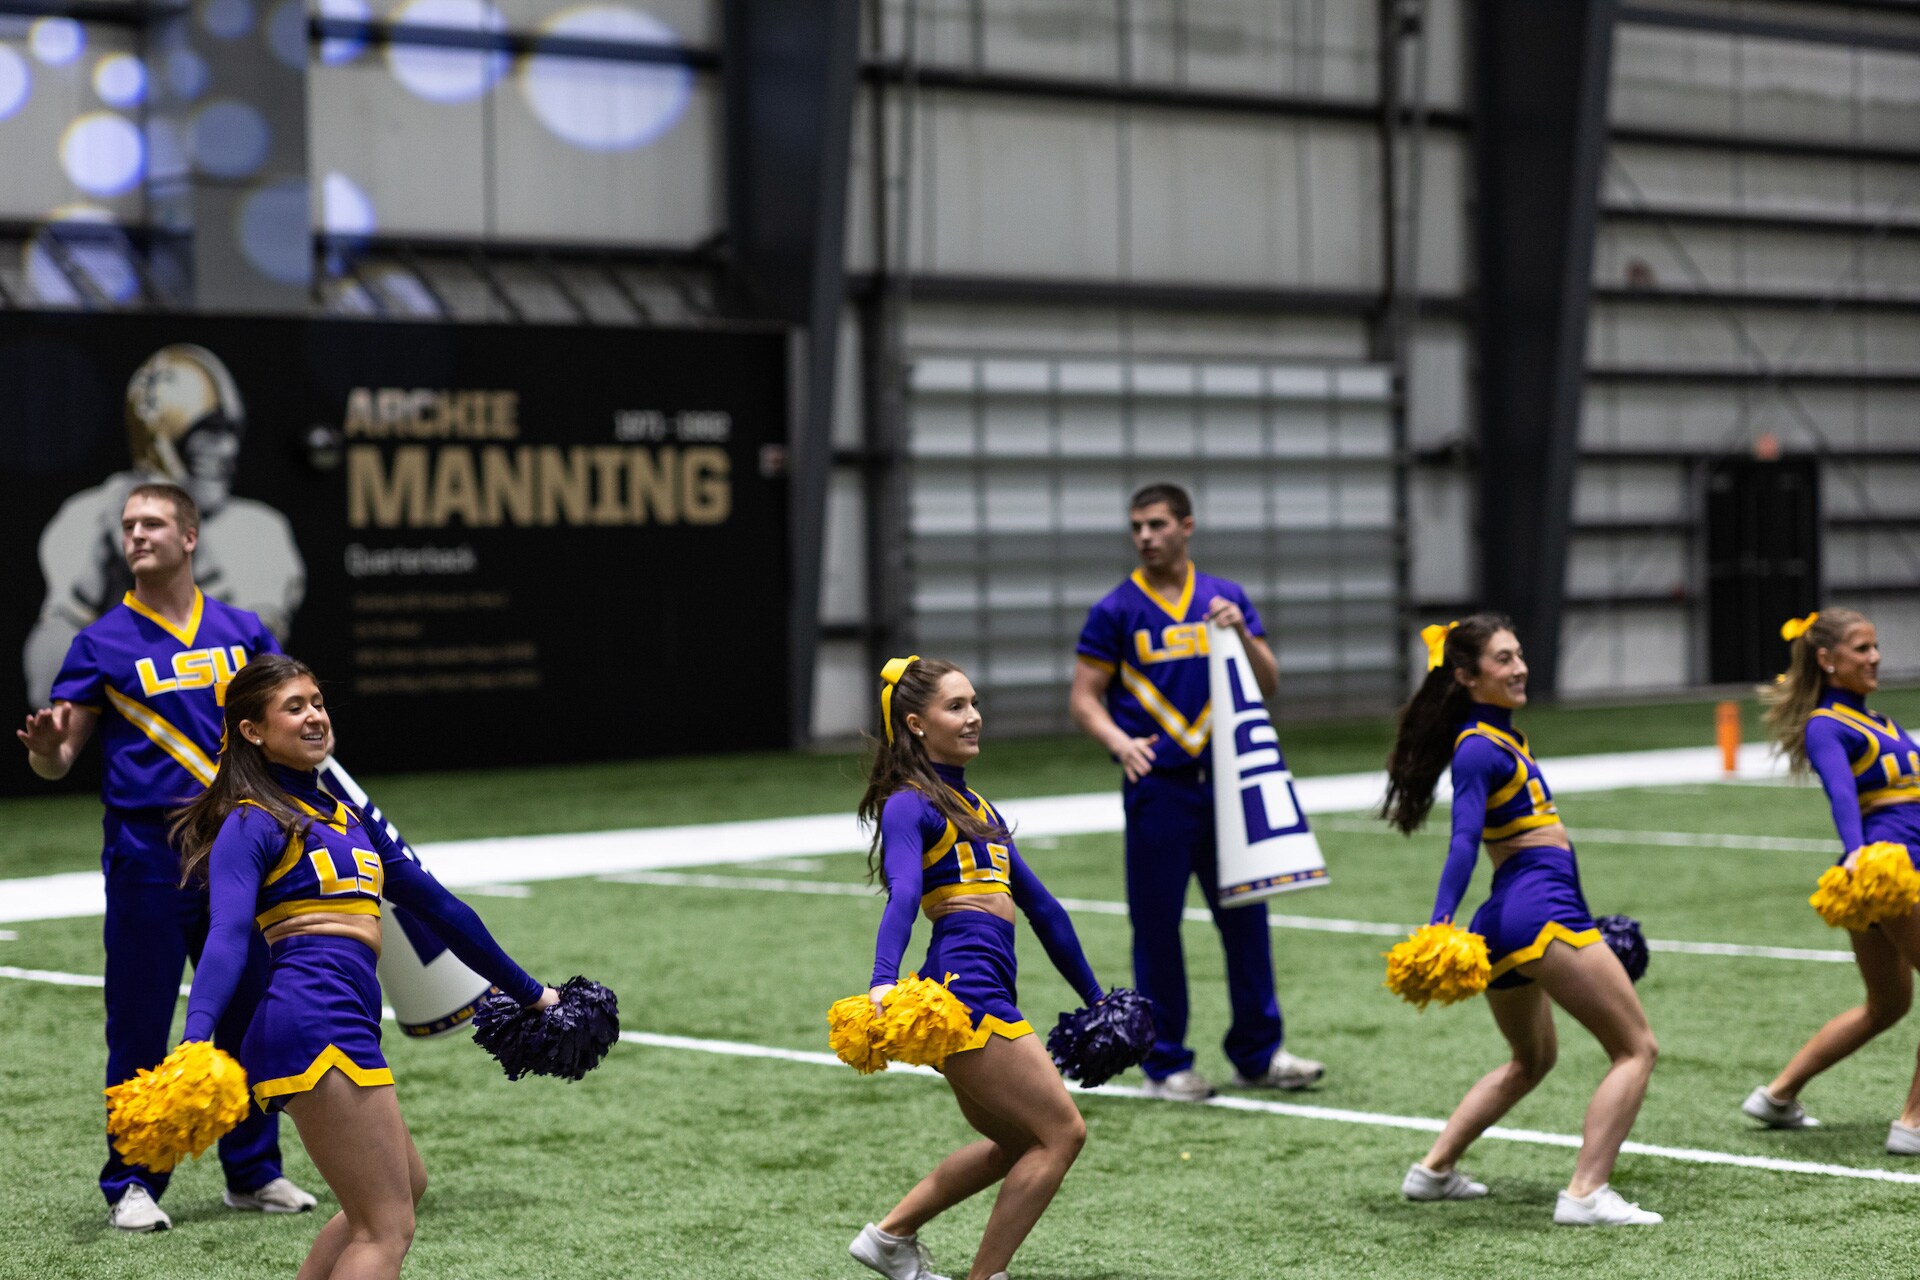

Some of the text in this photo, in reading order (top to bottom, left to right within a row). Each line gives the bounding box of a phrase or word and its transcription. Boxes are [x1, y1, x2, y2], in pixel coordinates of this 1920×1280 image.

[345, 388, 519, 440] ARCHIE
[347, 444, 732, 528] MANNING
[135, 645, 248, 698] LSU
[308, 847, 385, 901] LS
[954, 841, 1012, 886] LS
